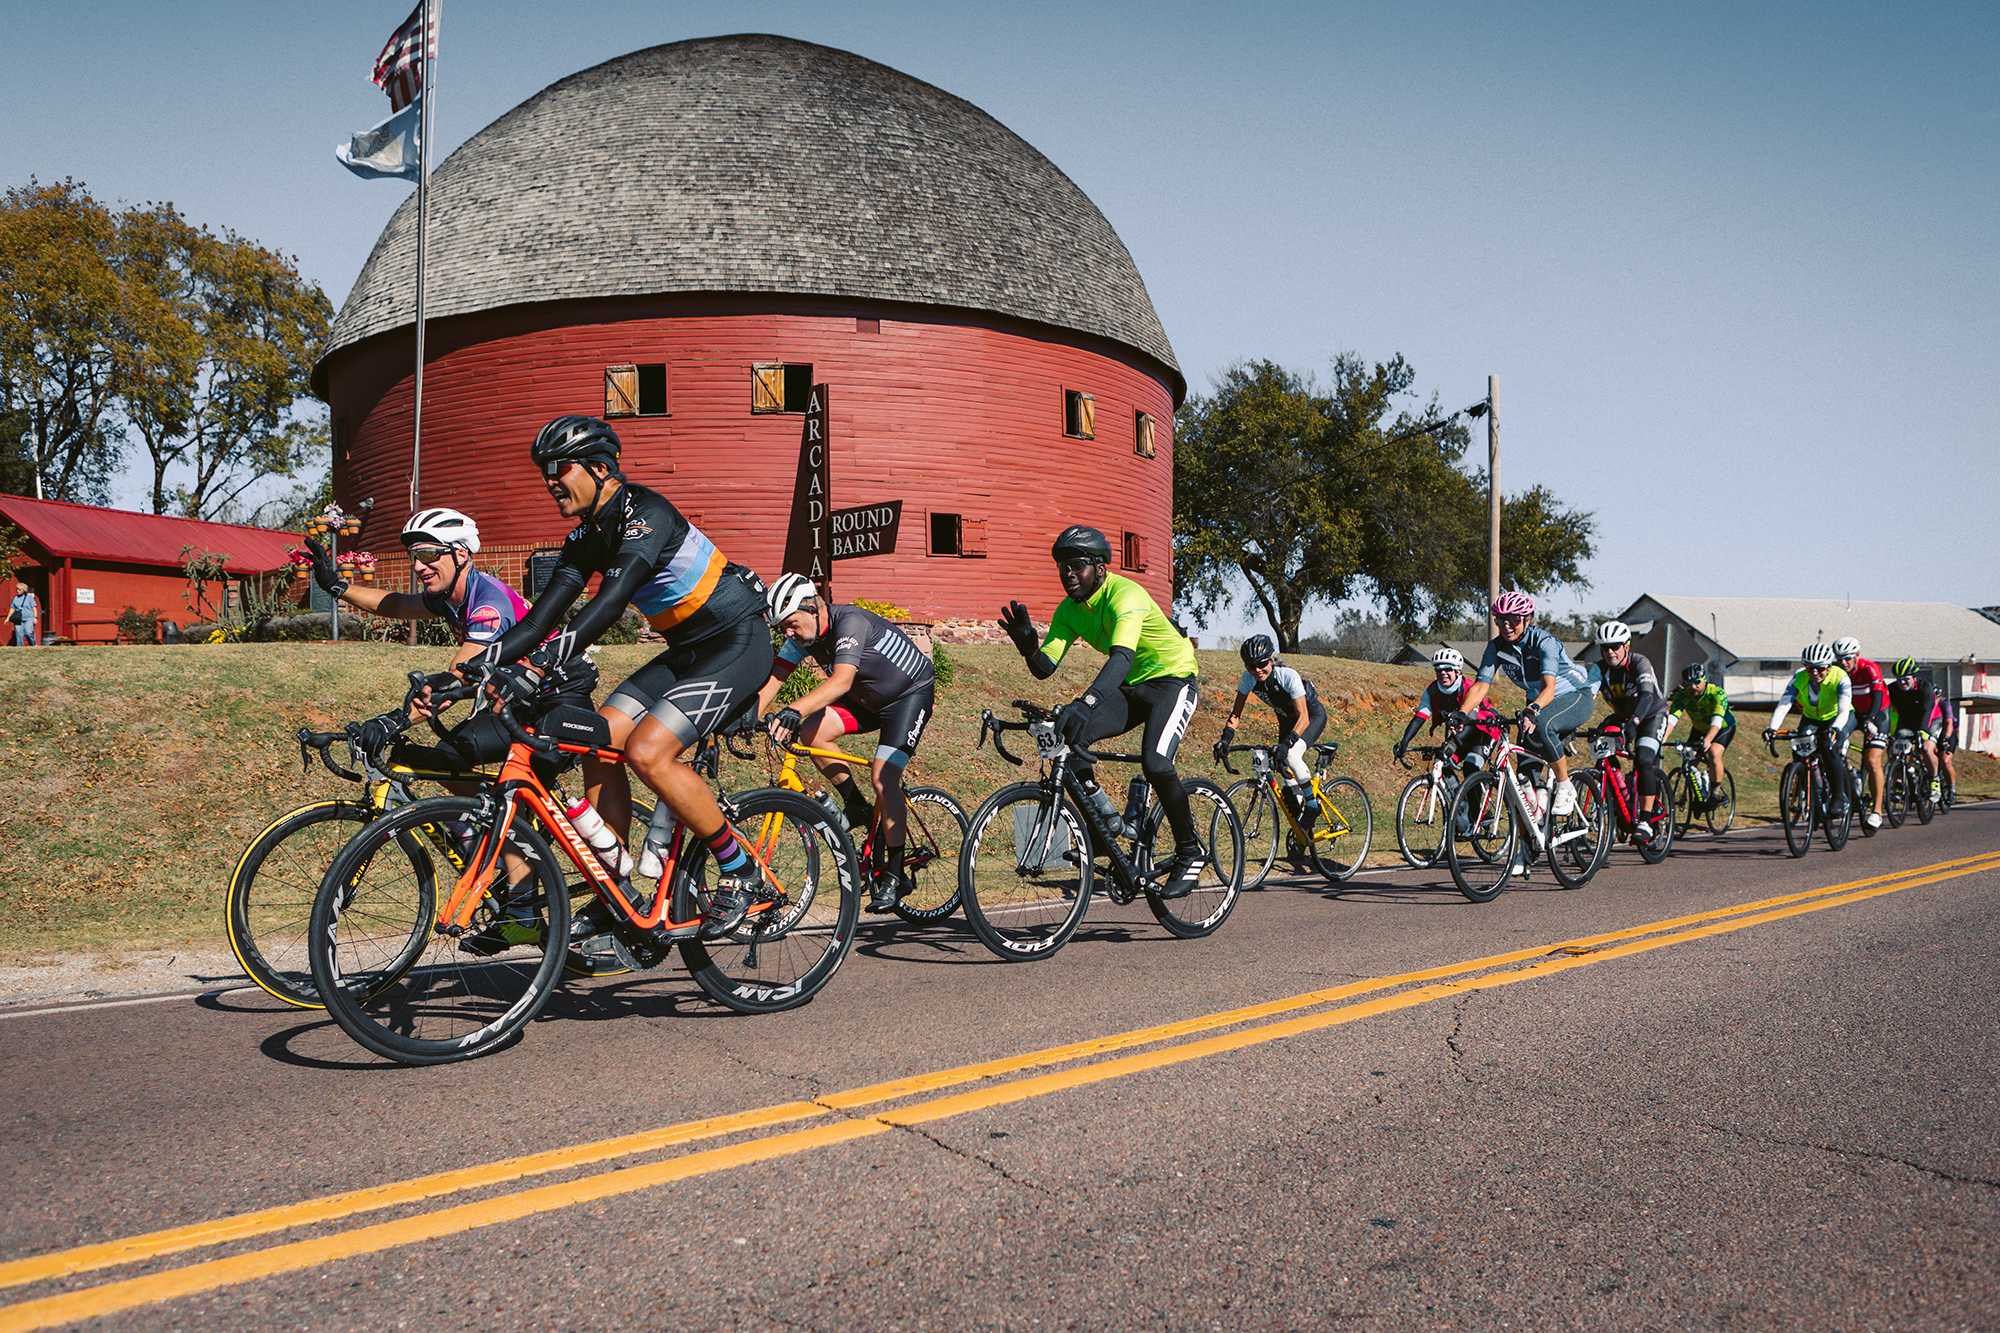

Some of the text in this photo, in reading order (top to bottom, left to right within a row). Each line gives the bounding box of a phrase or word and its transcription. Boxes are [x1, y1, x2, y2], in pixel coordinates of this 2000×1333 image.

[808, 391, 824, 577] ARCADIA
[832, 507, 893, 534] ROUND
[832, 532, 881, 557] BARN
[541, 796, 610, 882] SPECIALIZED
